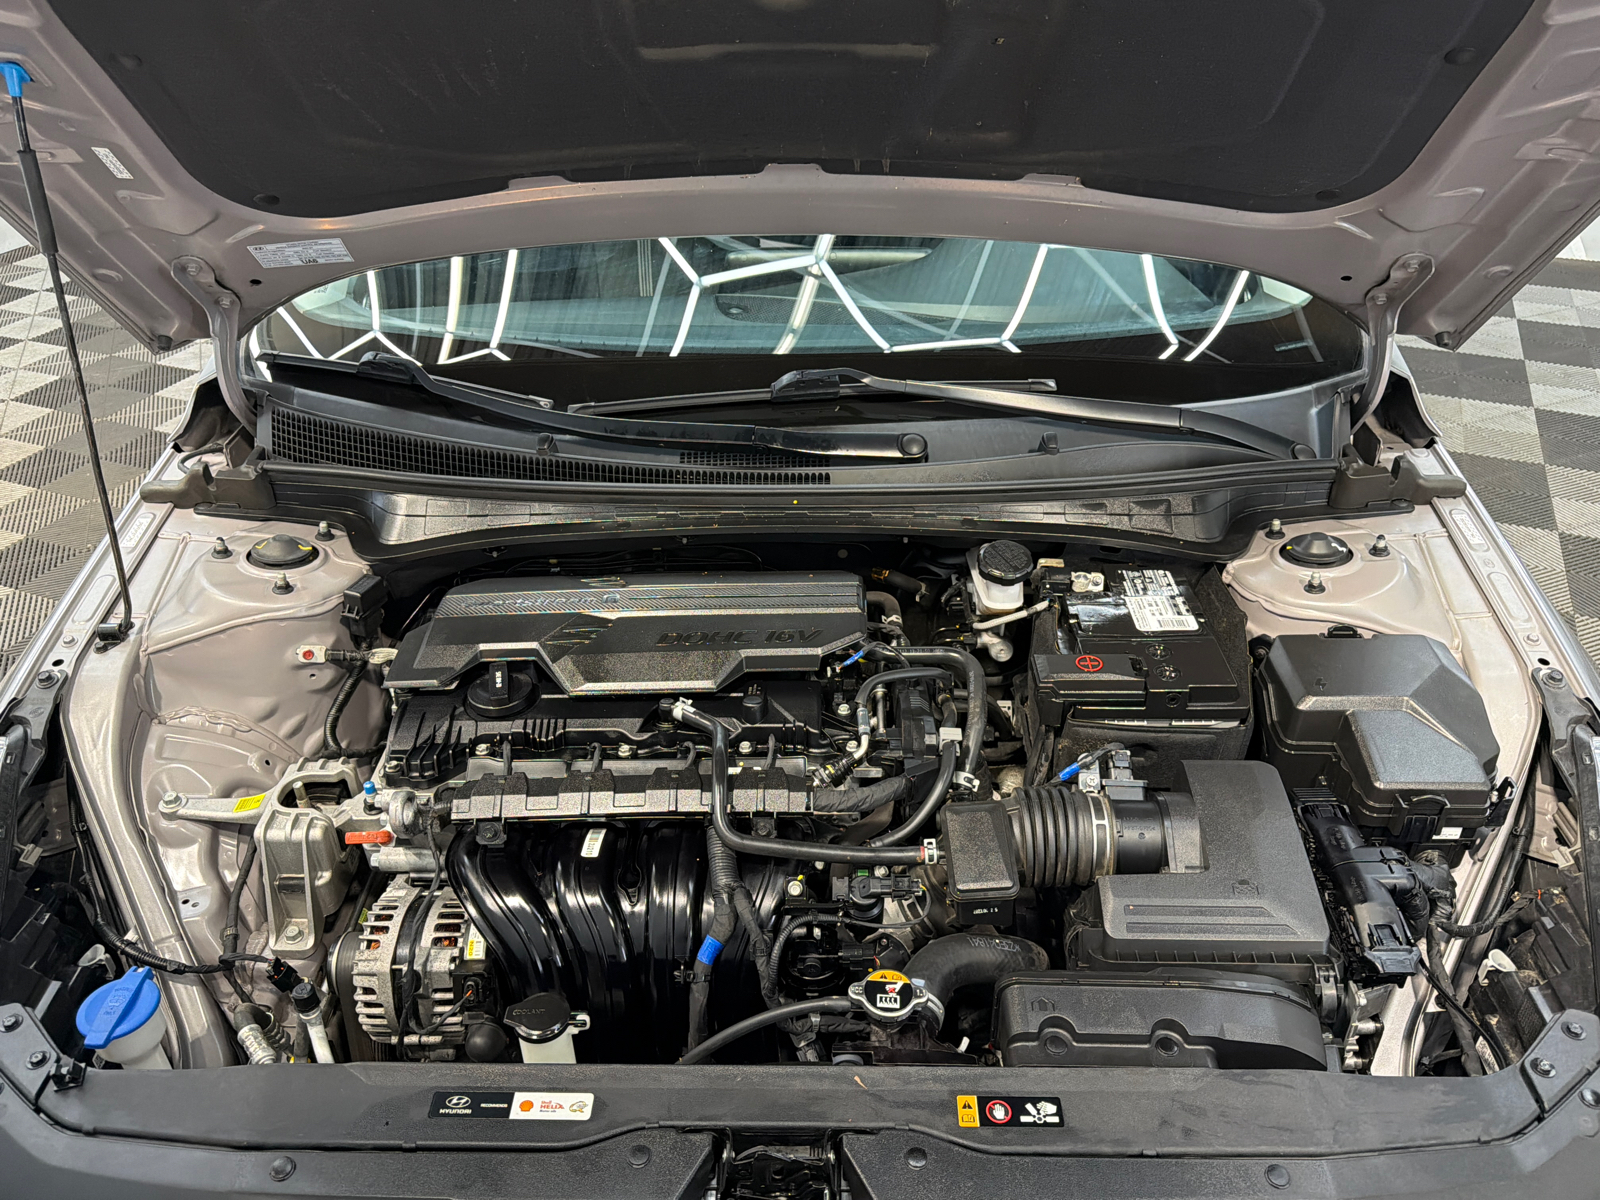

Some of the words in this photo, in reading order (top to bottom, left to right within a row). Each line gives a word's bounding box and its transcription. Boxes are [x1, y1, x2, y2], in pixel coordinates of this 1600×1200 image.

[655, 629, 757, 646] DOHC
[764, 628, 823, 644] 16V
[512, 1008, 546, 1016] COOLANT
